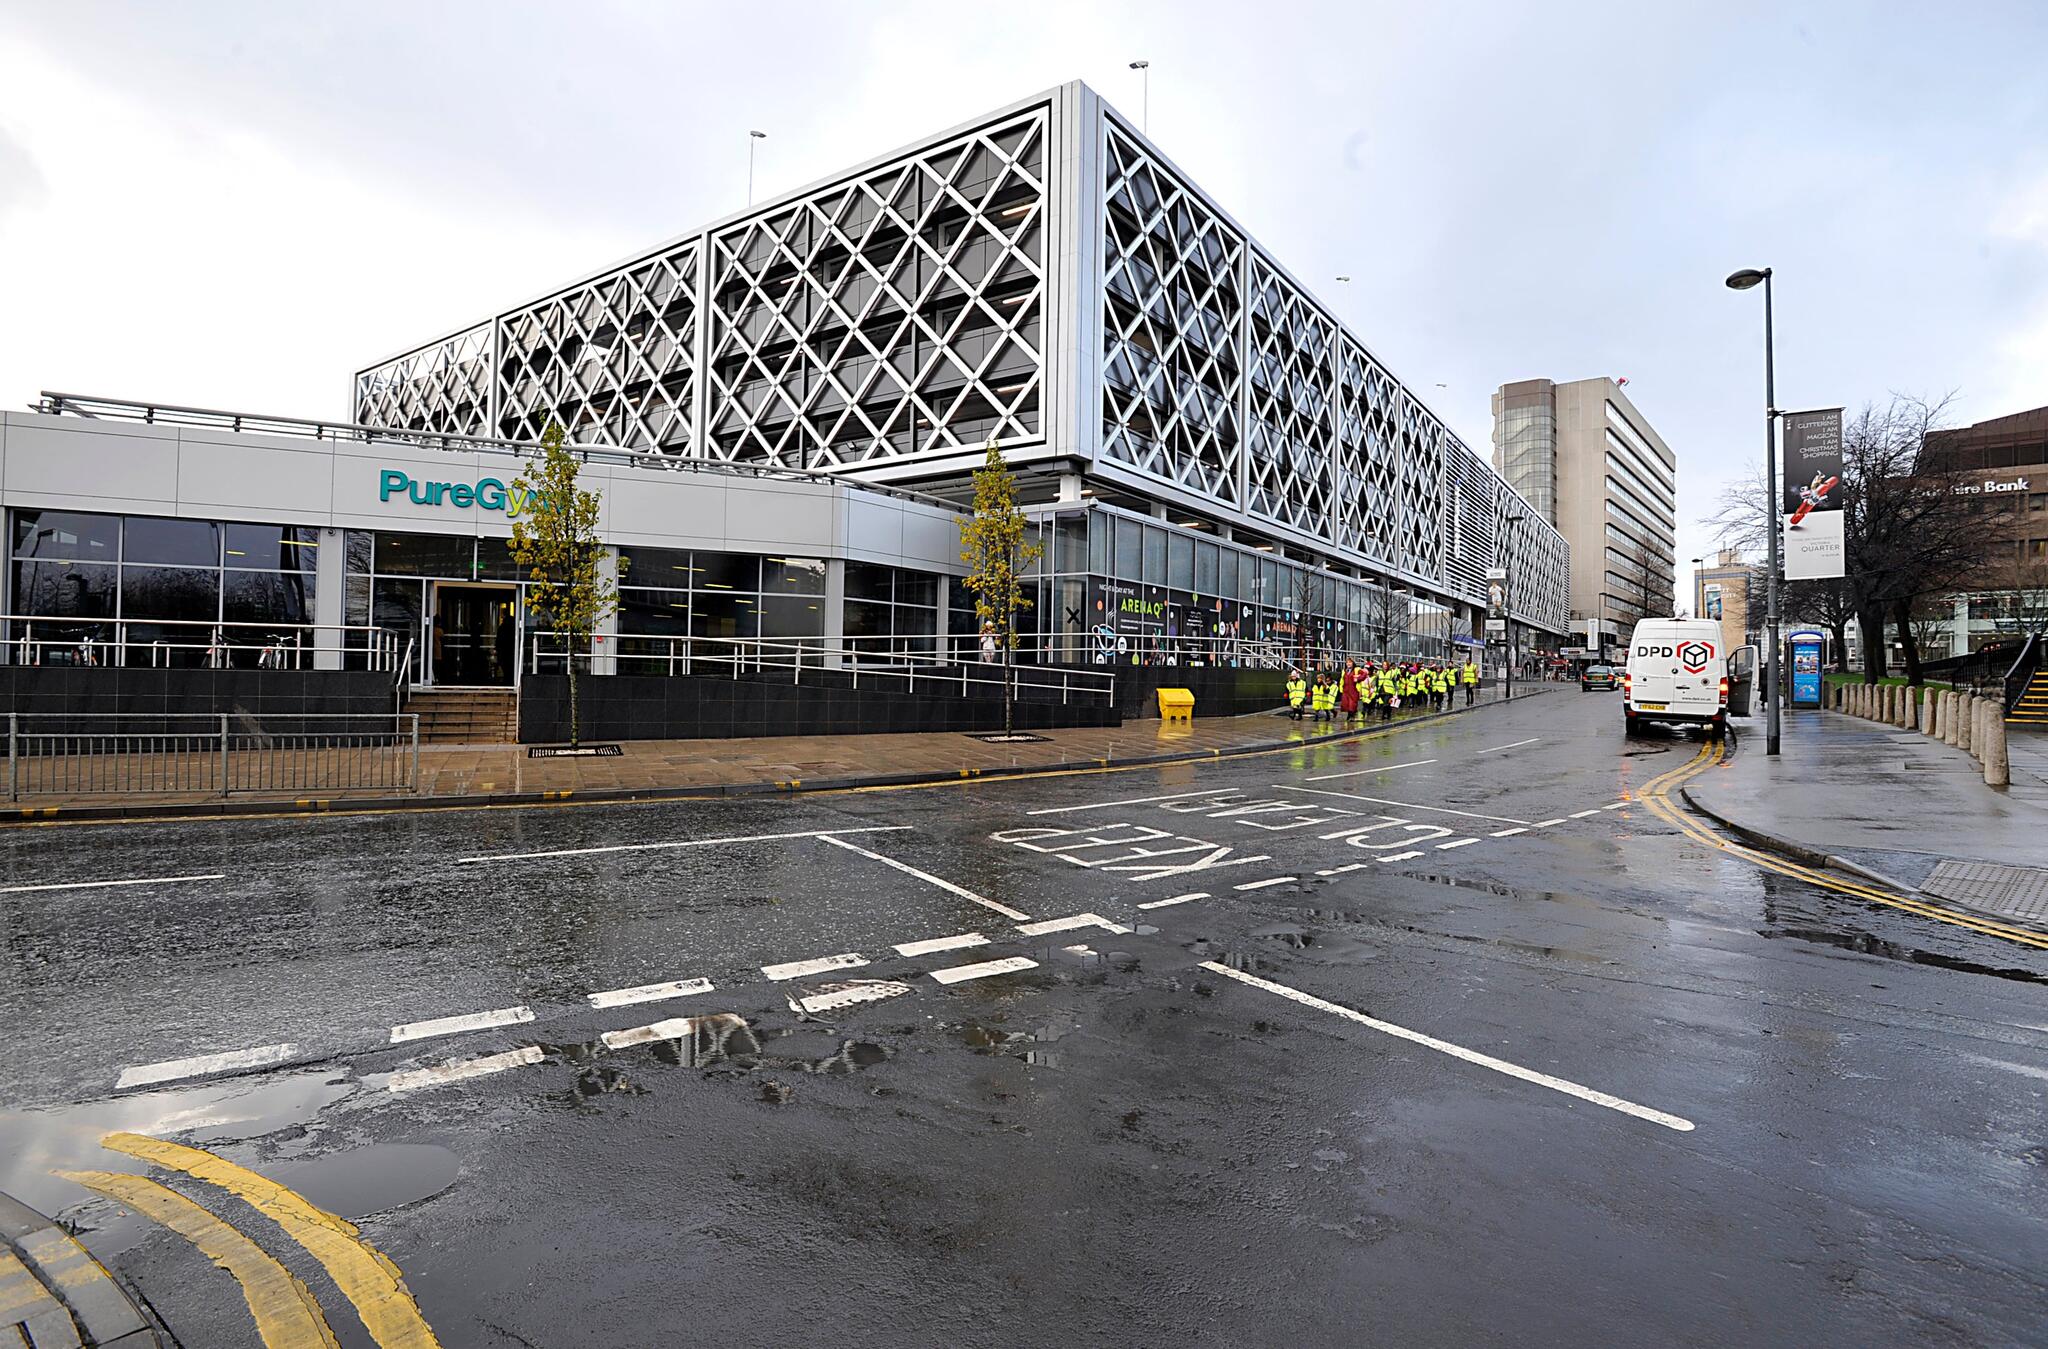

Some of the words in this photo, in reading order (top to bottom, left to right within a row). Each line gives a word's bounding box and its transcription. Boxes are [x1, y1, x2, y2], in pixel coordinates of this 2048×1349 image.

[1806, 432, 1838, 440] MAGICAL
[1799, 444, 1839, 453] CHRISTMAS
[1802, 451, 1839, 459] SHOPPING
[1984, 477, 2030, 493] Bank
[380, 469, 562, 518] PureGy
[1801, 544, 1840, 553] QUARTER
[1120, 598, 1153, 615] ARENA
[1637, 646, 1673, 658] DPD
